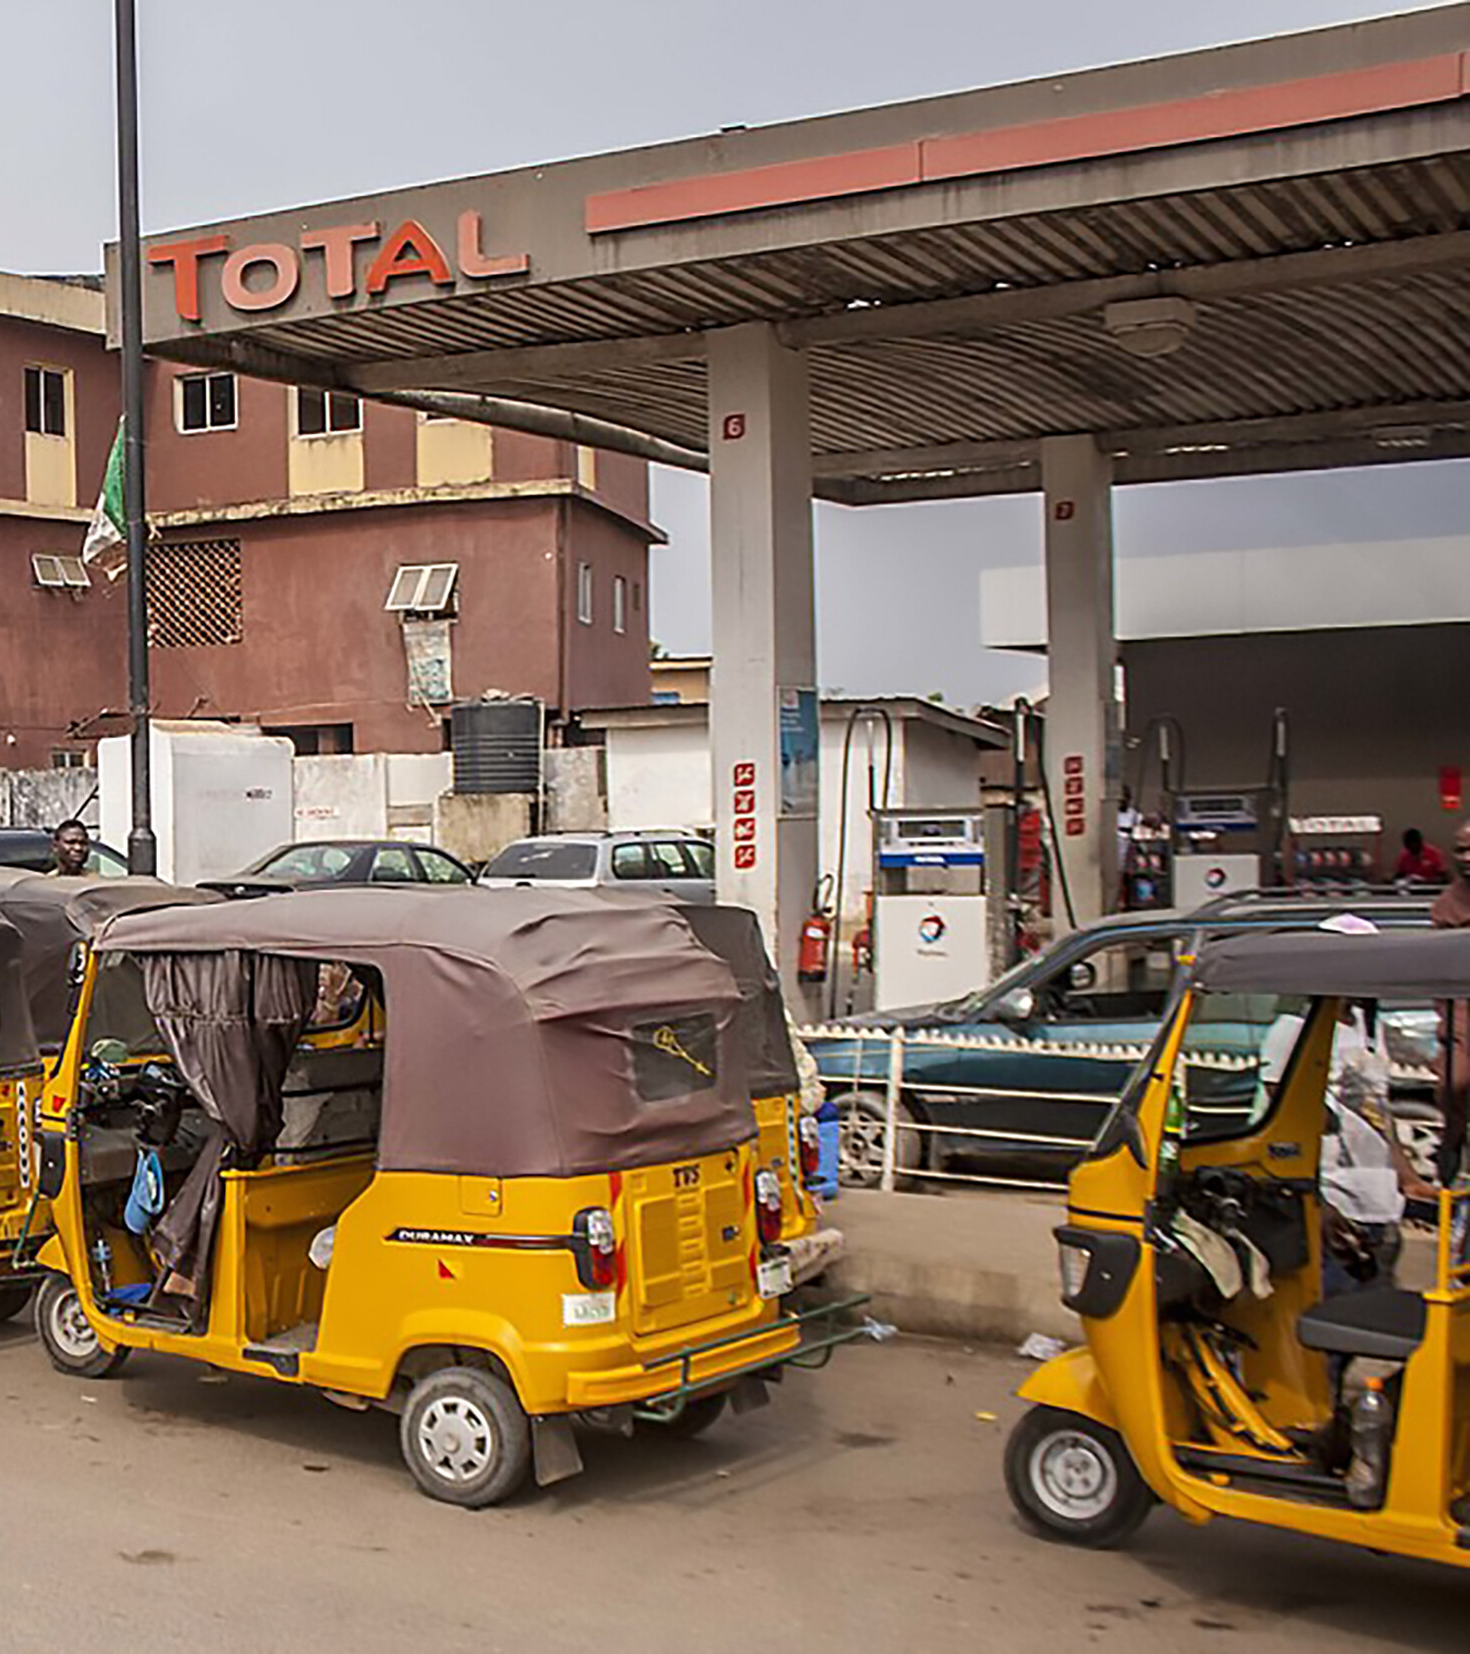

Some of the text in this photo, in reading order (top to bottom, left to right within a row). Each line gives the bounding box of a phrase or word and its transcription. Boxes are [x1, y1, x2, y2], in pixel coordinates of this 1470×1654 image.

[146, 207, 531, 322] TOTAL
[729, 418, 741, 436] 6
[673, 1163, 700, 1188] TVS
[398, 1229, 475, 1244] DURAMAX
